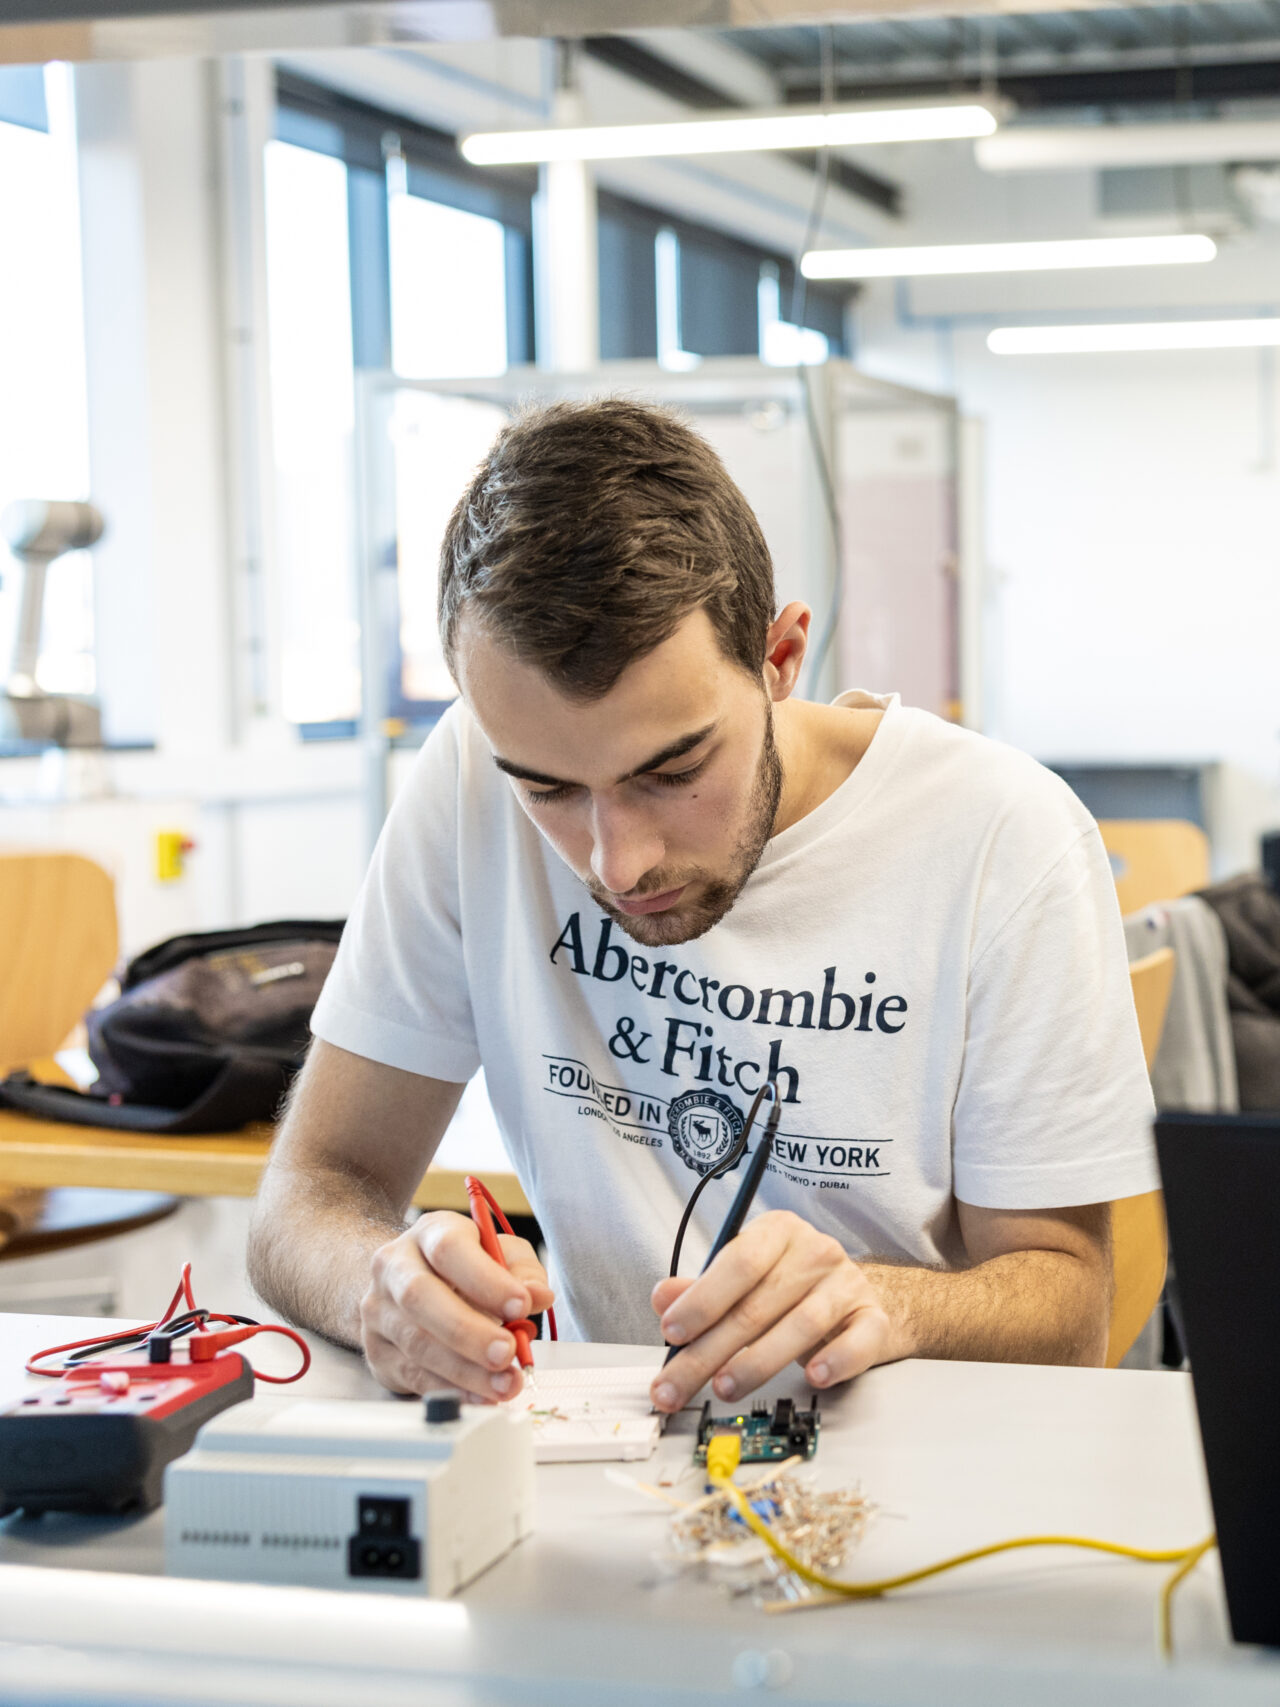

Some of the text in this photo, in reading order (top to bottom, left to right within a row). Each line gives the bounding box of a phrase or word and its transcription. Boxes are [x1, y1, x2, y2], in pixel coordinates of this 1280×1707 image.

[550, 911, 908, 1034] Abercrombie
[608, 1016, 802, 1104] & Fitch
[638, 1100, 661, 1125] IN
[722, 1107, 742, 1136] FITCH
[622, 1131, 663, 1148] ANGELES
[815, 1144, 880, 1168] YORK
[784, 1171, 810, 1187] TOKYO
[819, 1180, 850, 1190] DUBAI
